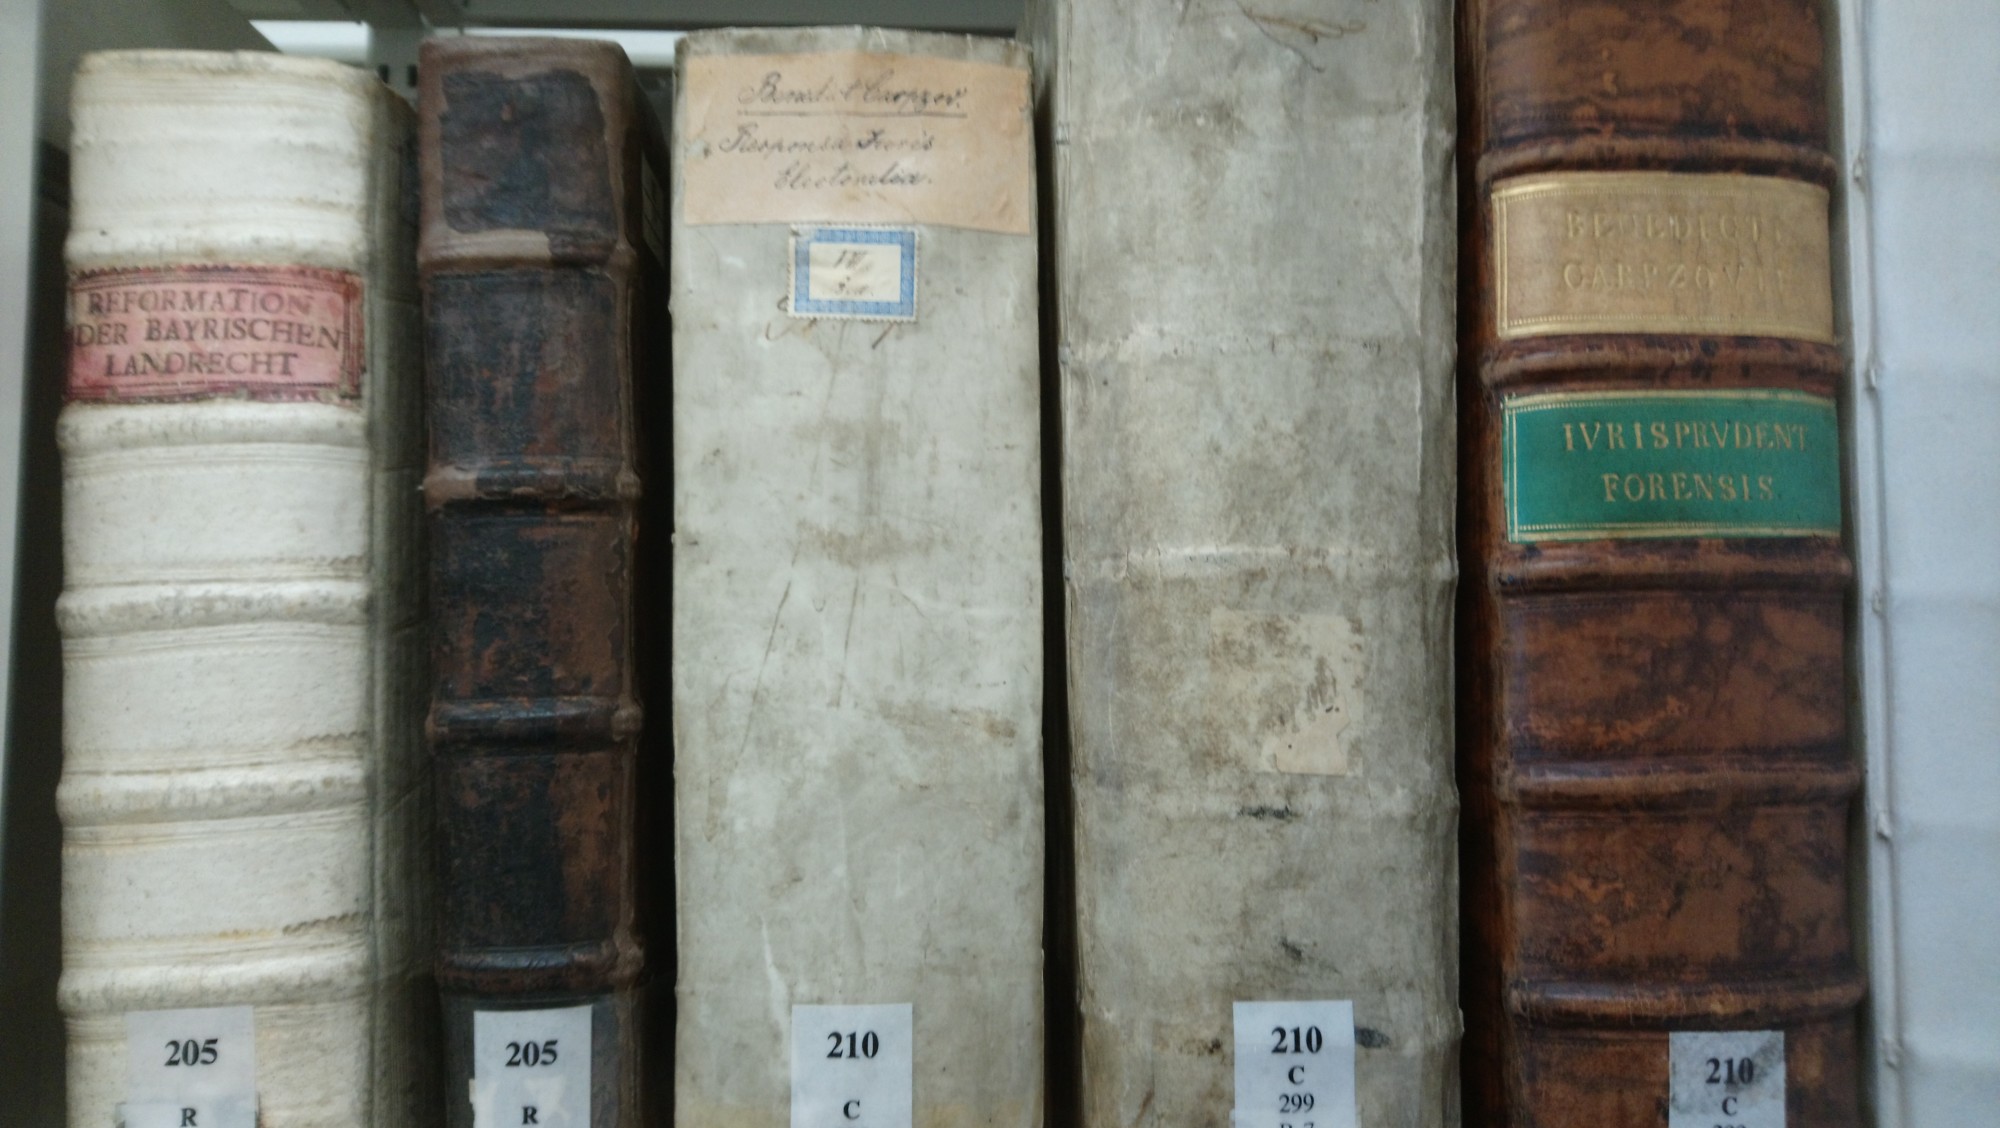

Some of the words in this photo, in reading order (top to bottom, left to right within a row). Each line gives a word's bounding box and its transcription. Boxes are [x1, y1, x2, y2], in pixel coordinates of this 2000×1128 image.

[87, 286, 315, 318] REFORMATION
[73, 321, 129, 348] DER
[144, 317, 346, 351] BAYRISCHEN
[103, 351, 299, 377] LANDRECHT
[1562, 419, 1809, 452] IVRISPRVDENT
[164, 1038, 219, 1067] 205
[505, 1039, 558, 1067] 205
[826, 1030, 880, 1060] 210
[1271, 1025, 1323, 1054] 210
[1287, 1065, 1305, 1085] C
[1705, 1056, 1754, 1084] 210
[180, 1107, 198, 1127] R
[521, 1106, 539, 1125] R
[842, 1100, 861, 1120] C
[1278, 1092, 1315, 1114] 299
[1721, 1096, 1738, 1116] C
